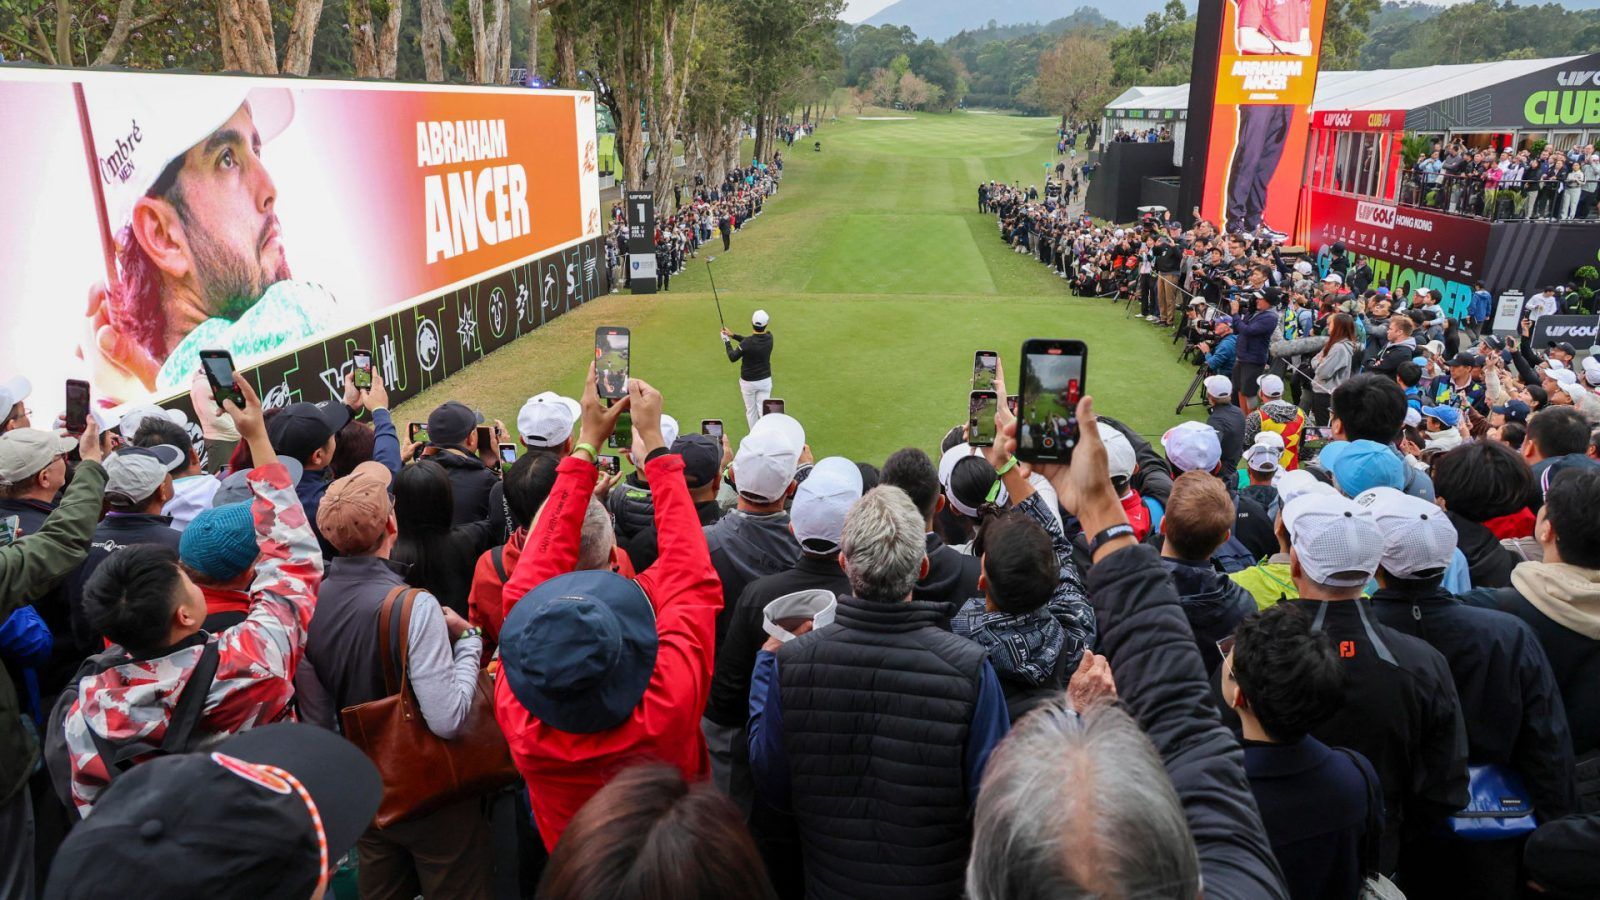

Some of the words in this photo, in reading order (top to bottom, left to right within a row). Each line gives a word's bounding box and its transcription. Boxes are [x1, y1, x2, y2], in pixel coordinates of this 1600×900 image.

[1524, 90, 1600, 125] CLUB
[416, 119, 508, 167] ABRAHAM
[425, 164, 531, 265] ANCER
[637, 203, 645, 223] 1
[1396, 215, 1415, 229] HONG
[1414, 218, 1433, 232] KONG
[1340, 641, 1355, 657] FJ
